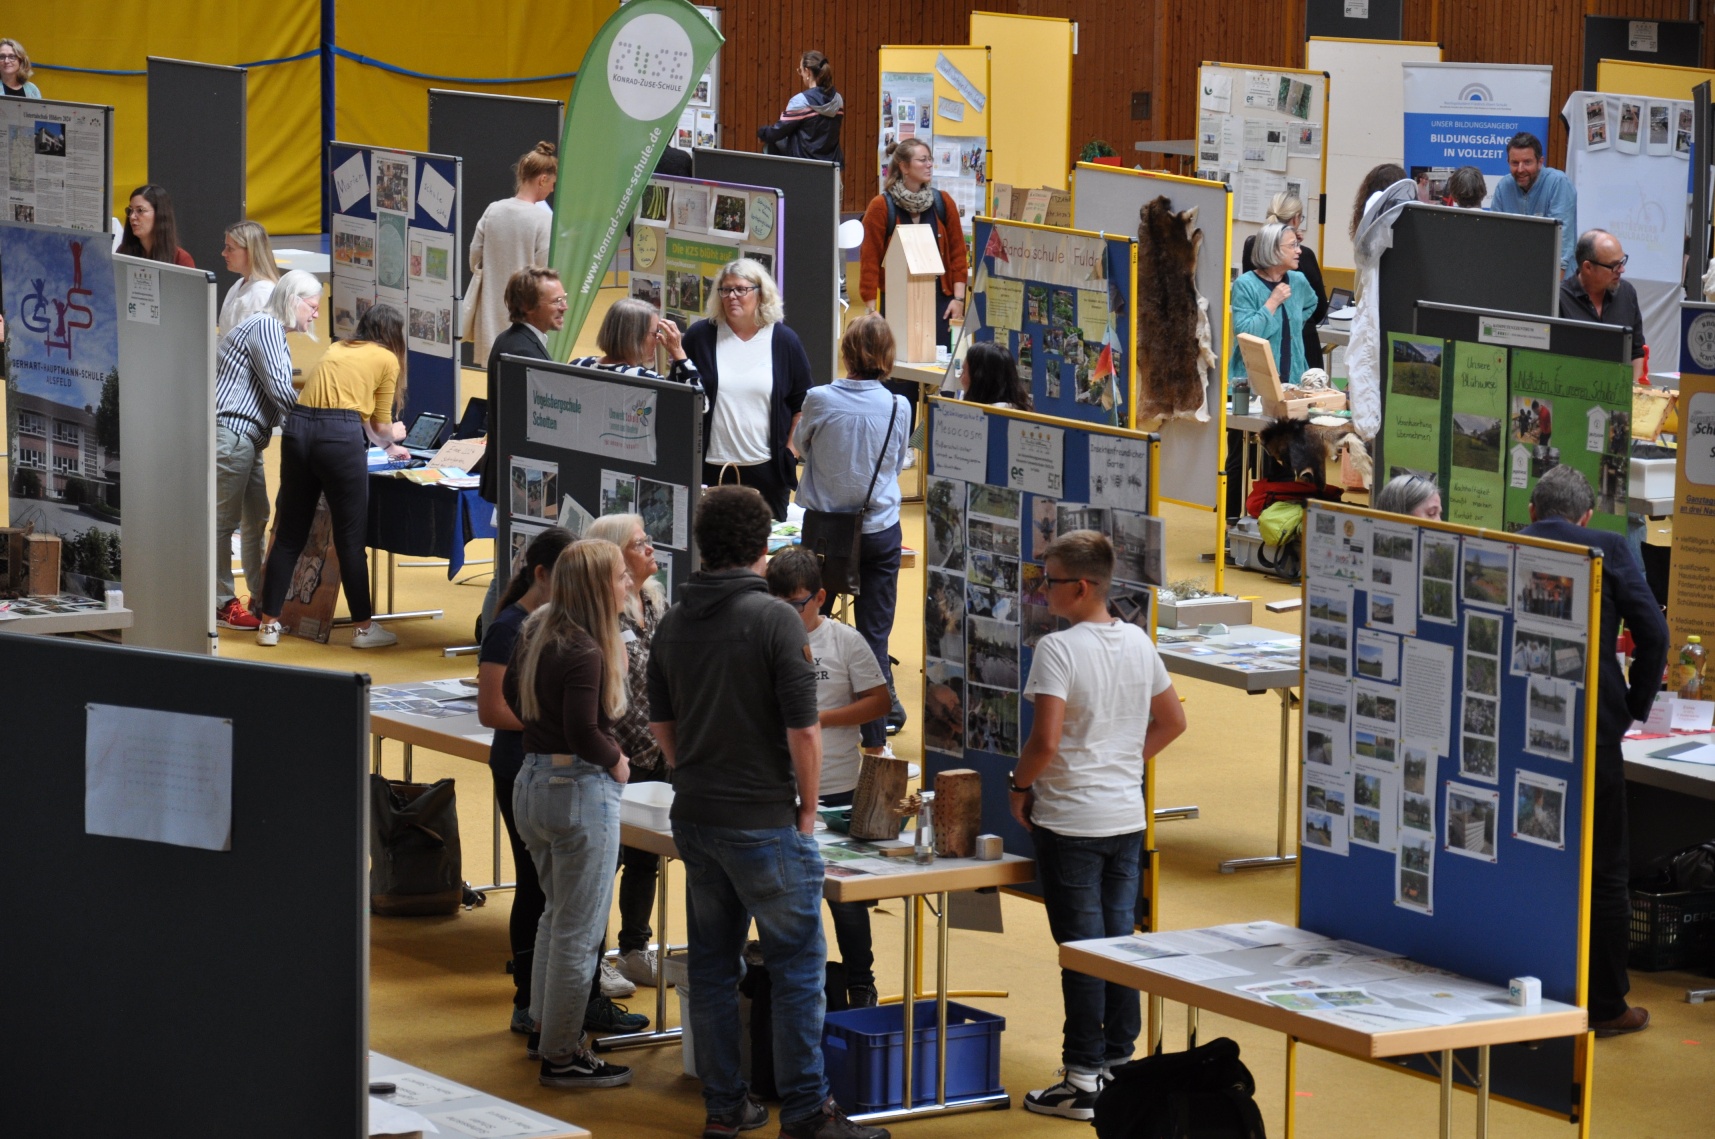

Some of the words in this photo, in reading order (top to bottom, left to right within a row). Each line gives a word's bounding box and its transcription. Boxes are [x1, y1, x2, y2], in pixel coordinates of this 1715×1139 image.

[1431, 120, 1453, 128] UNSER
[1454, 121, 1519, 130] BILDUNGSANGEBOT
[1430, 133, 1512, 145] BILDUNGSGÄNG
[1443, 148, 1455, 157] IN
[1457, 149, 1504, 159] VOLLZEIT
[580, 126, 662, 295] www.konrad-zuse-schule.de
[672, 243, 684, 255] Die
[685, 245, 699, 257] KZS
[12, 358, 105, 383] GERHART-HAUPTMANN-SCHULE
[46, 374, 73, 388] ALSFELD
[532, 389, 582, 414] Vogelsbergschule
[532, 410, 558, 430] Schotten
[935, 420, 982, 440] Mesocosm
[1689, 505, 1702, 513] drei
[1678, 572, 1715, 582] Hausaufgabe
[814, 657, 822, 666] Y
[815, 670, 830, 680] ER
